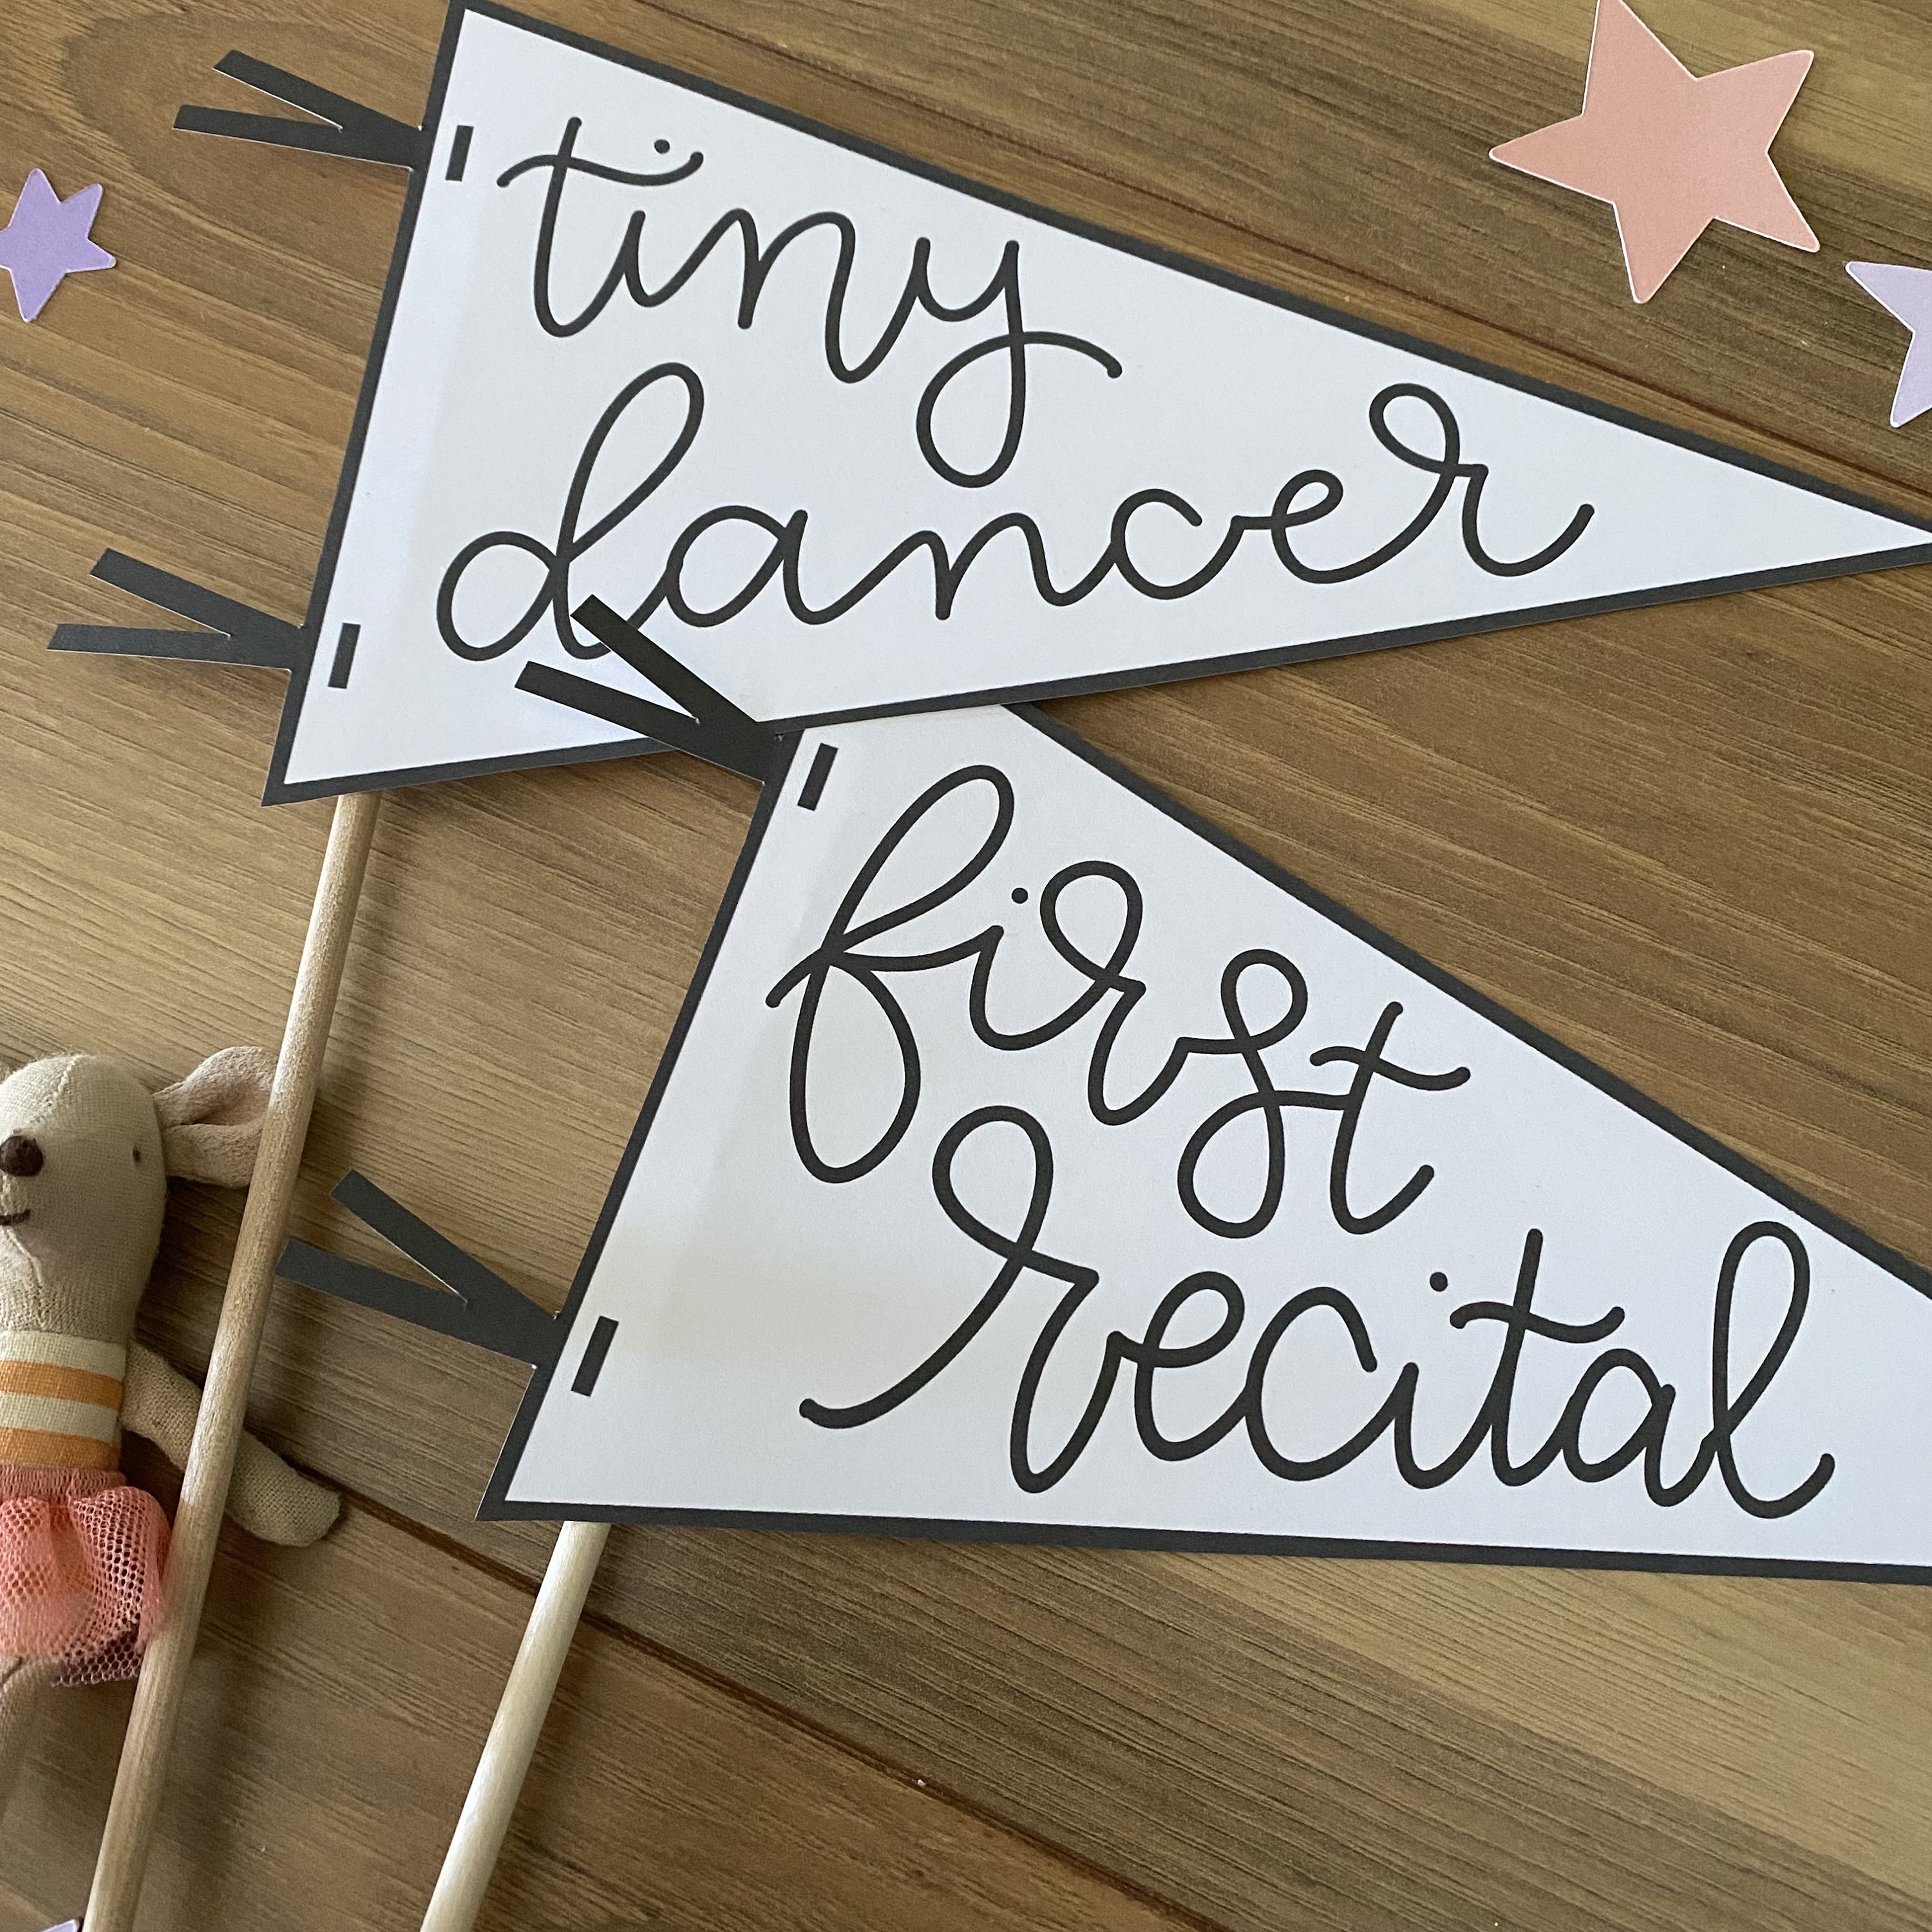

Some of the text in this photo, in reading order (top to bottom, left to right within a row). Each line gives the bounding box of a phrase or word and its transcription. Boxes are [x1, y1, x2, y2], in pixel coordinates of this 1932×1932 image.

[497, 117, 1122, 488] tiny
[437, 363, 1595, 661] dancer
[766, 765, 1470, 1238] first
[799, 1106, 1835, 1519] recital
